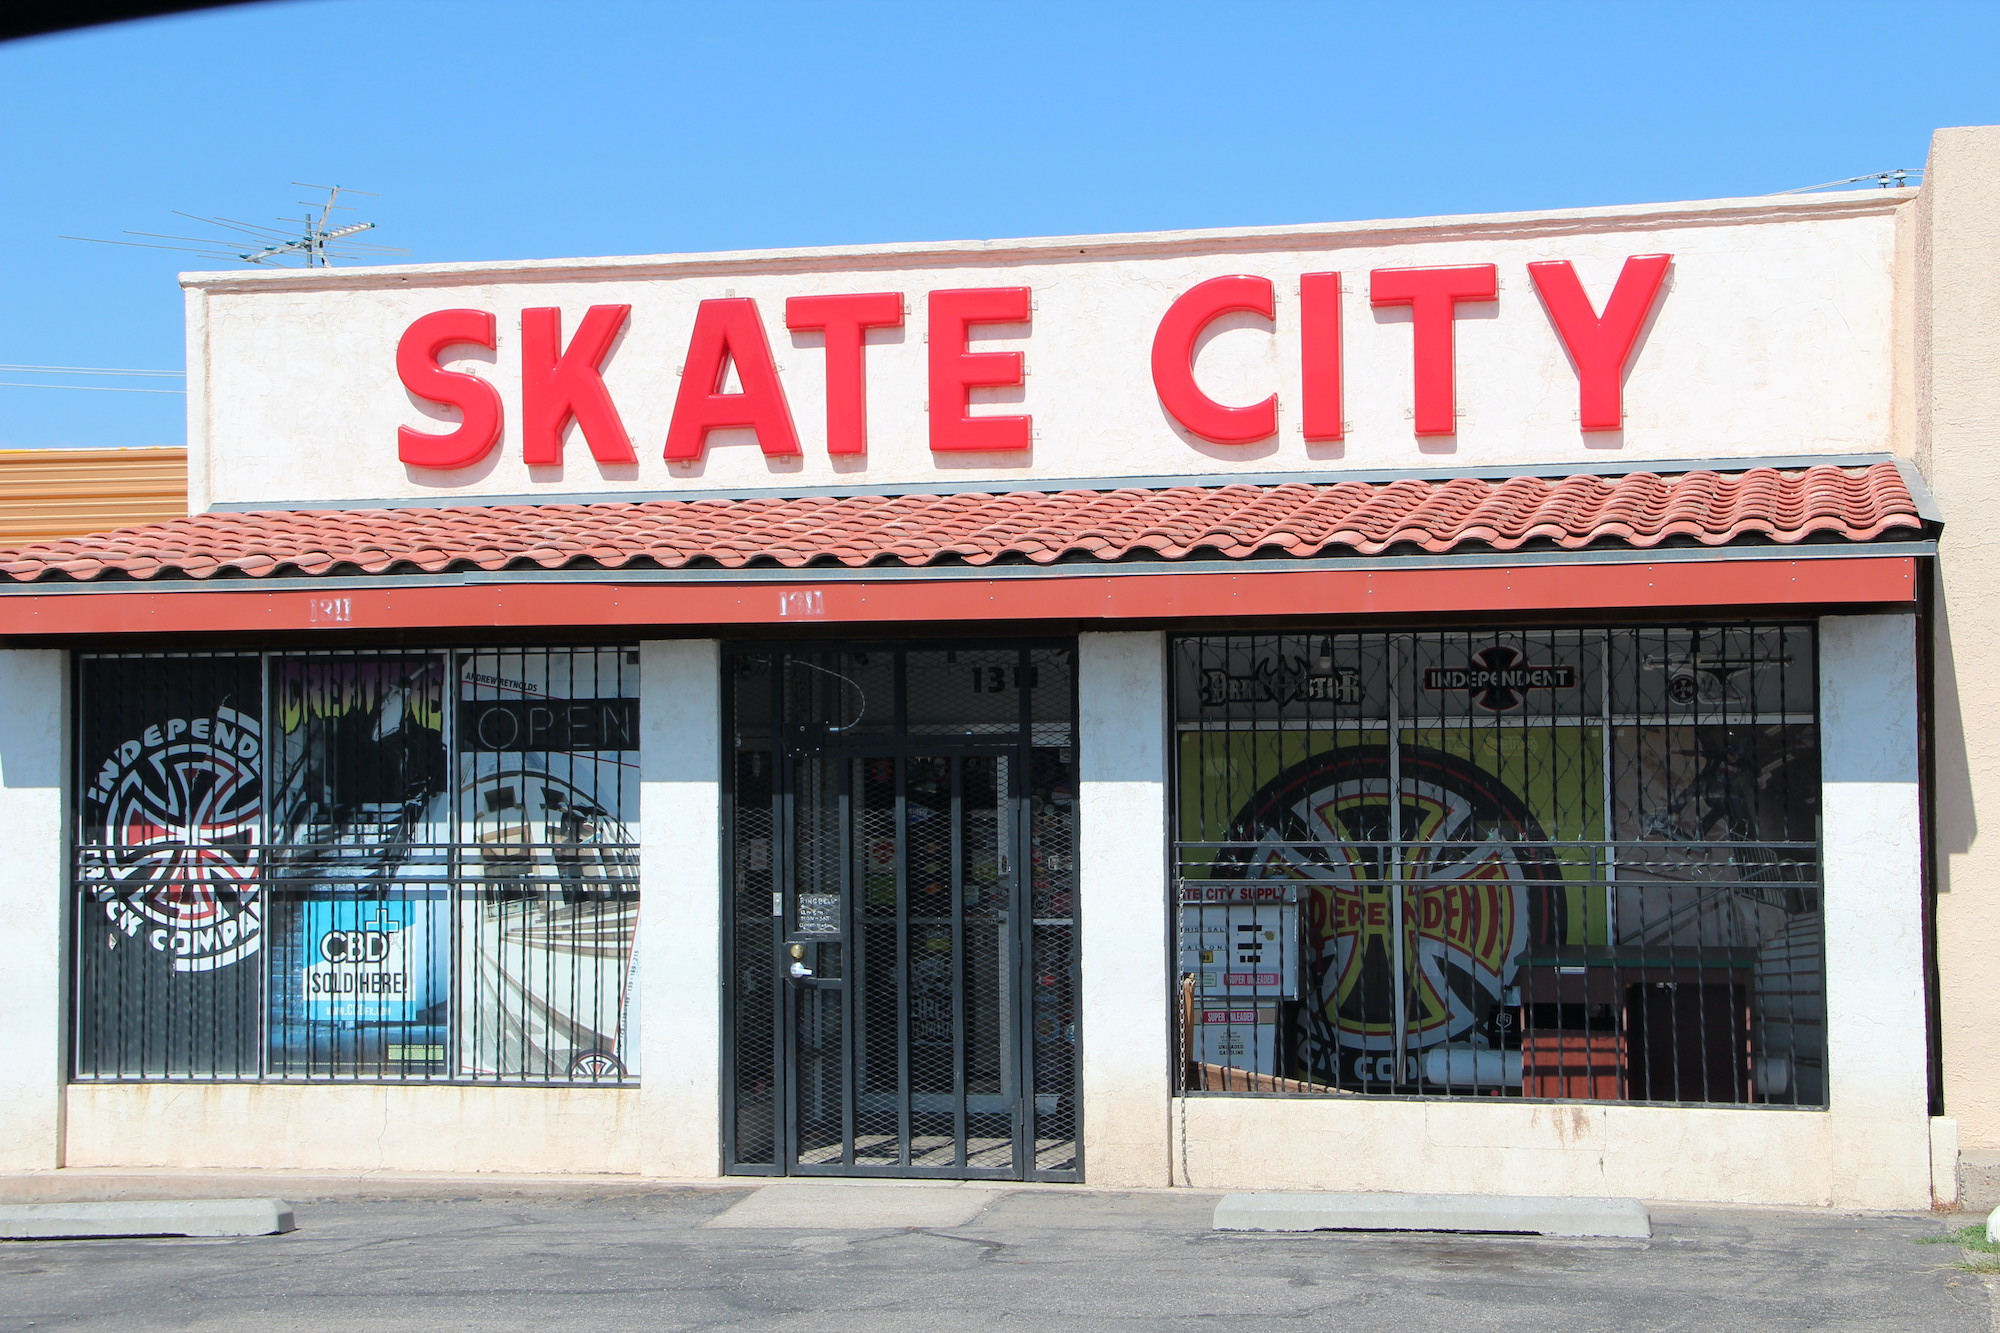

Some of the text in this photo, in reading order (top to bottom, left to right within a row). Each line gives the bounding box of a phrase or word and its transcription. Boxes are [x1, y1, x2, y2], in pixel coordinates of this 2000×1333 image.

[397, 253, 1675, 471] SKATE CITY
[465, 672, 537, 693] ANDREW REYNOLDS
[1431, 669, 1568, 688] INDEPENDENT
[478, 706, 631, 750] OPEN
[1206, 888, 1234, 900] CITY
[1240, 887, 1286, 900] SUPPLY
[320, 929, 389, 964] CBD
[312, 972, 408, 994] SOLD HERE!
[1229, 974, 1246, 985] SUPER
[1207, 1012, 1254, 1022] SUPER NLEADED
